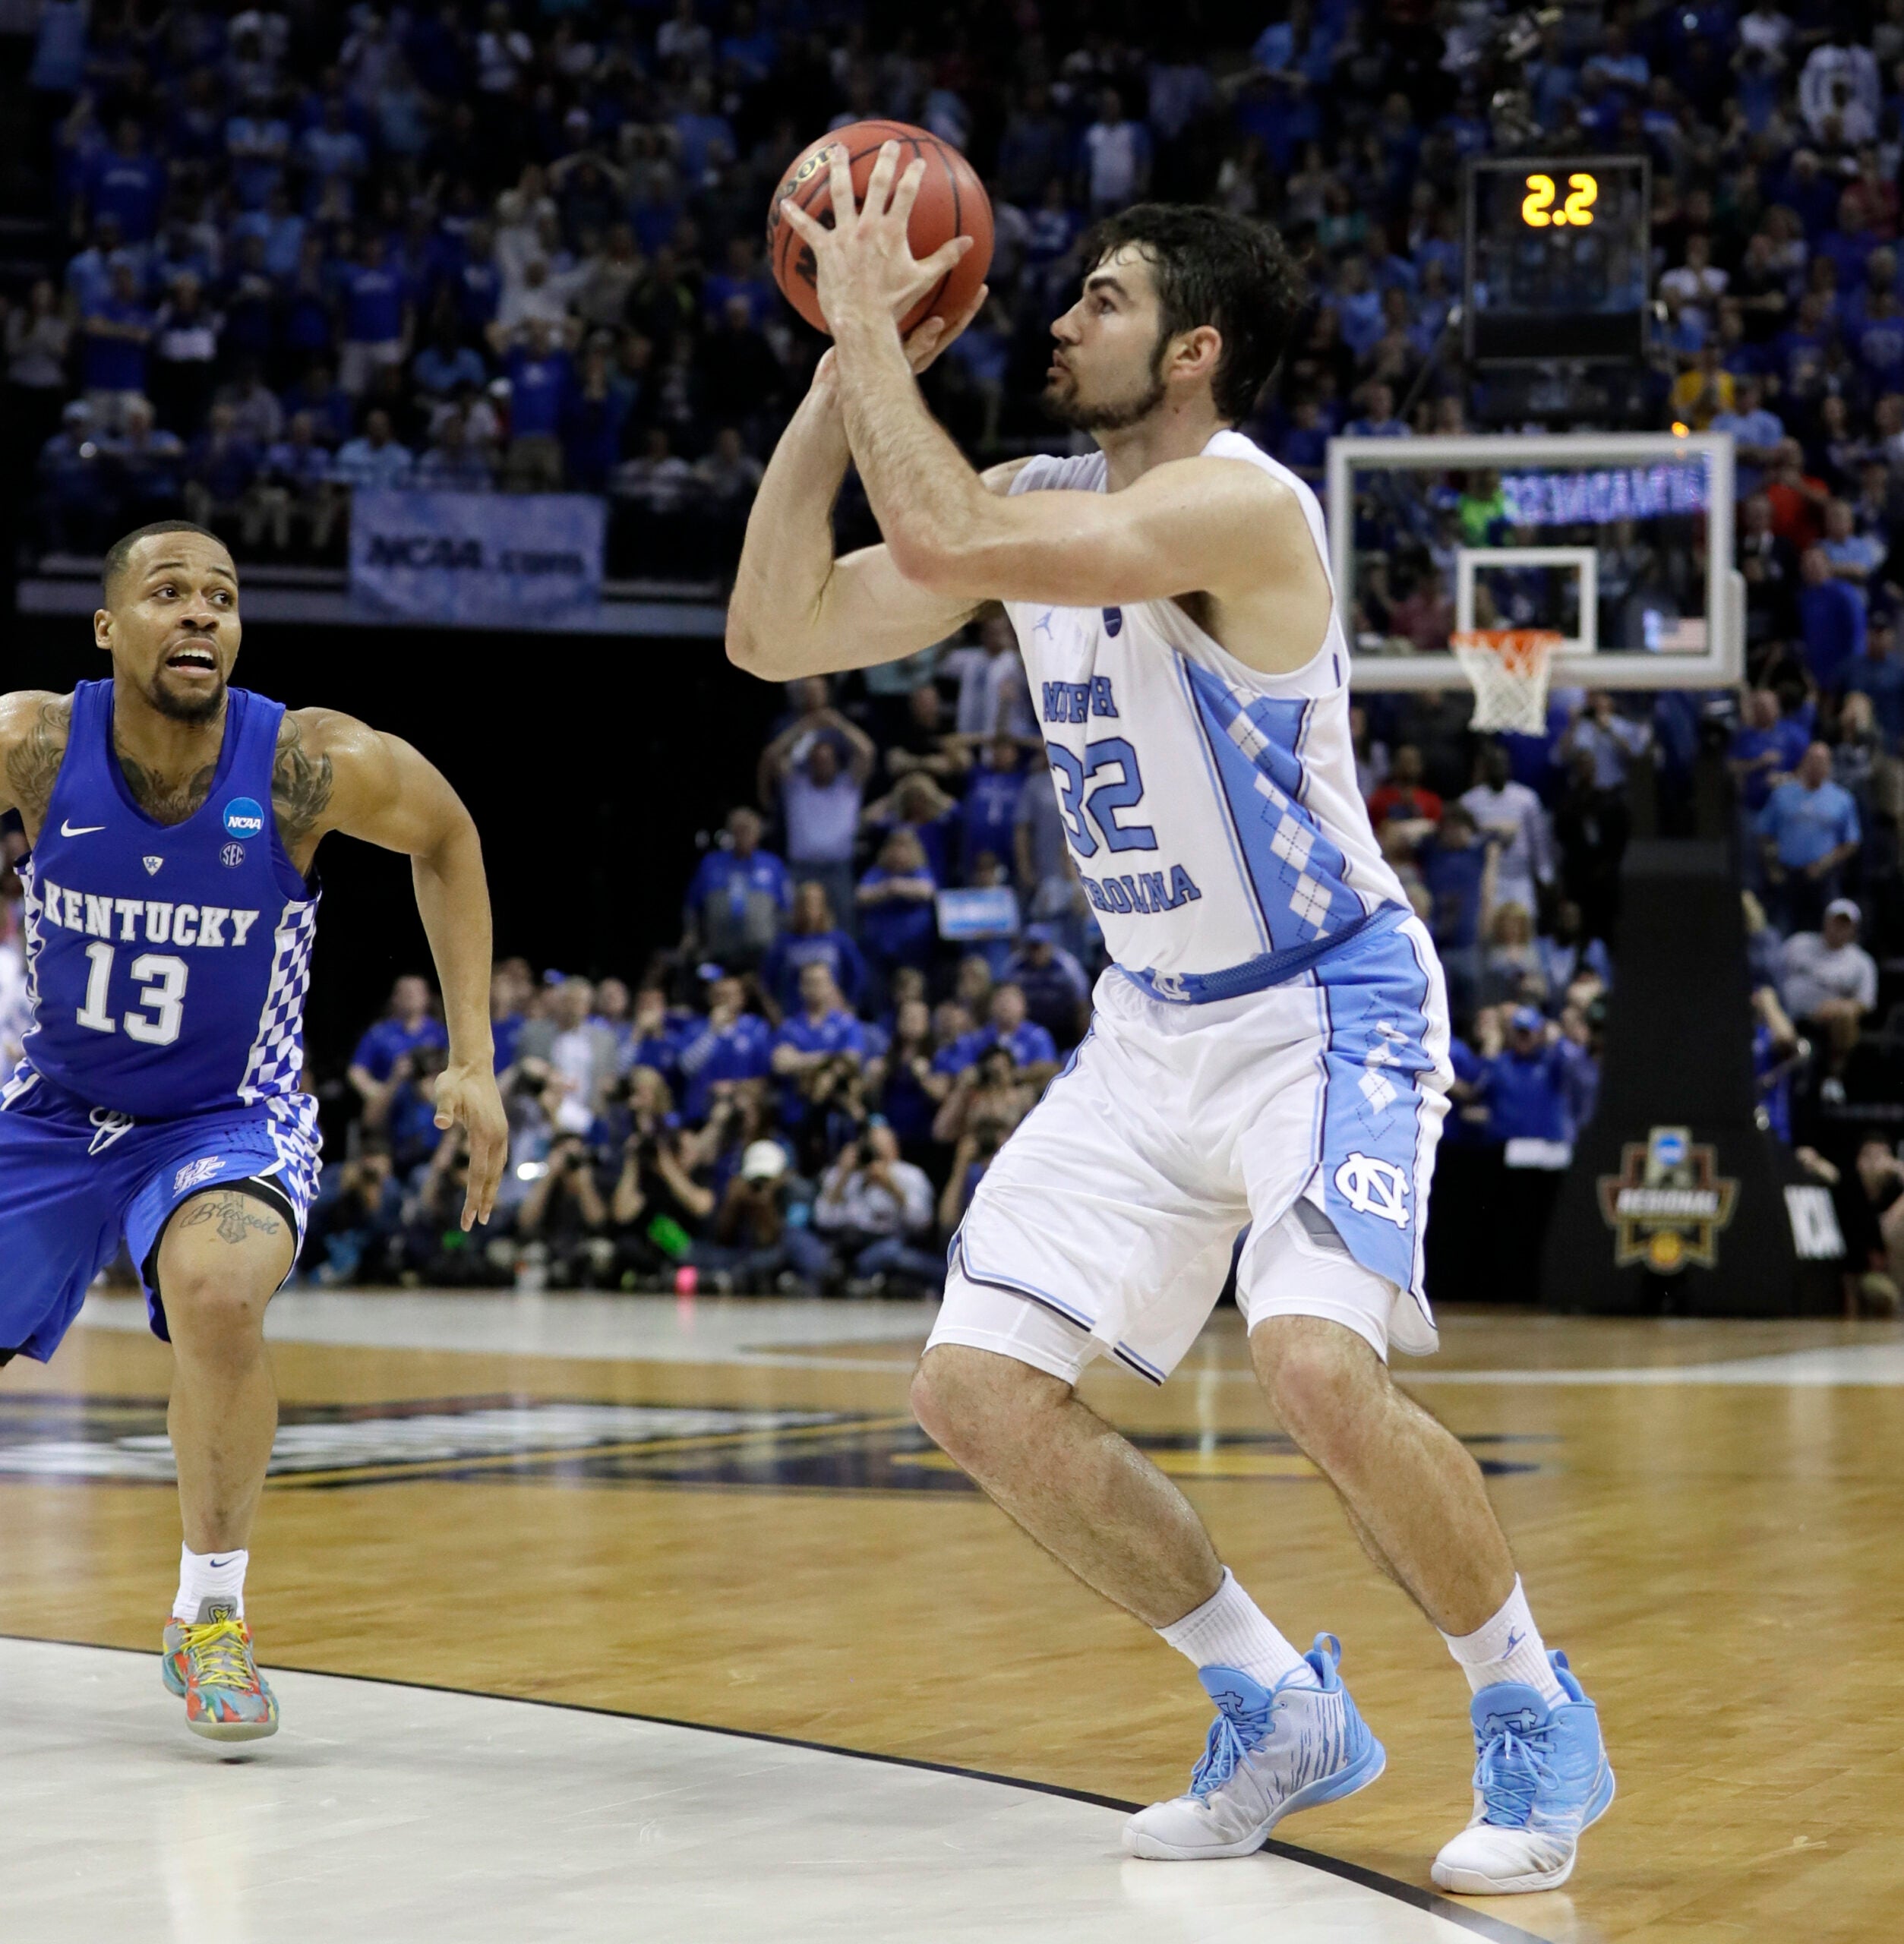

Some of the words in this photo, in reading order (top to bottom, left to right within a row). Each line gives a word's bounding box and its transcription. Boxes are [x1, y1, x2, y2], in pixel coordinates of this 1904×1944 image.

[1522, 173, 1598, 227] 2.2
[228, 816, 261, 830] NCAA
[1046, 737, 1158, 858] 32
[223, 844, 243, 866] SEC
[43, 878, 260, 947] KENTUCKY
[76, 940, 188, 1046] 13
